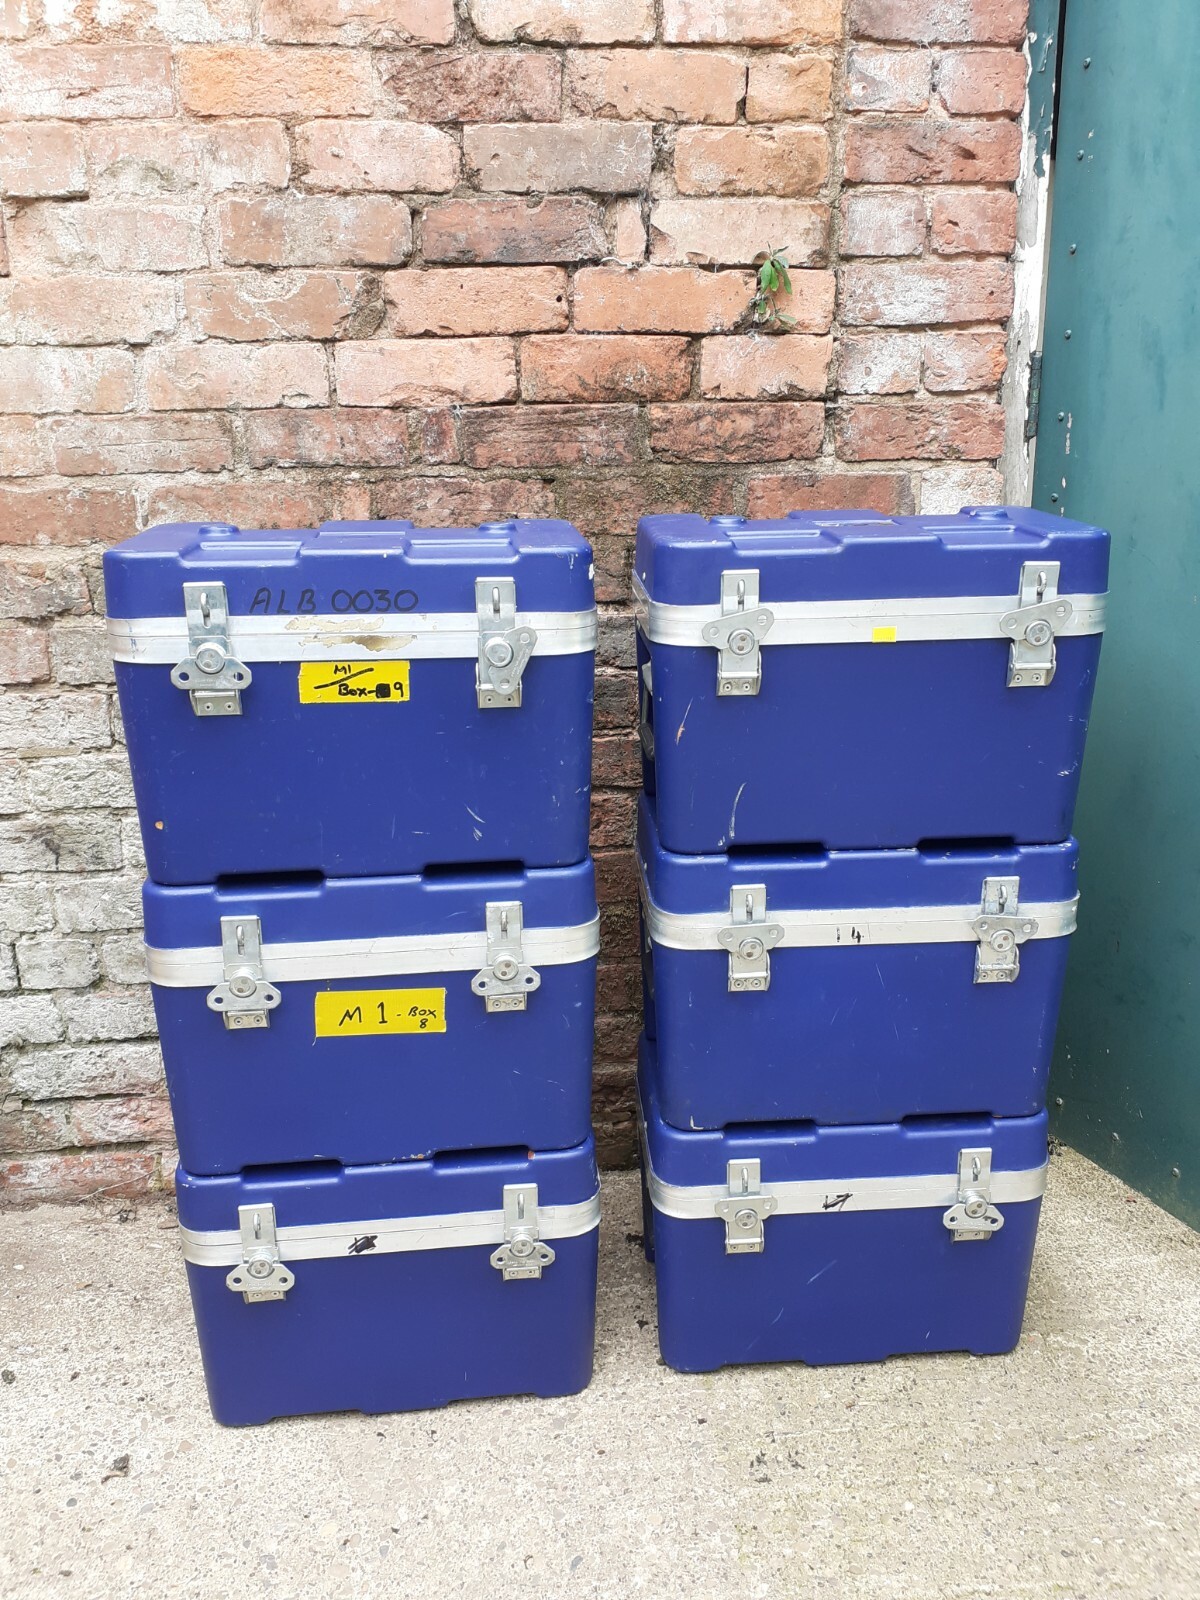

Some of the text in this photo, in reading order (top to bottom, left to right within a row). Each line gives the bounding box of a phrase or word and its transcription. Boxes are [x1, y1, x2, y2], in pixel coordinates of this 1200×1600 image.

[250, 587, 419, 614] ALB 0030
[338, 1005, 362, 1027] M
[419, 1018, 429, 1029] 8
